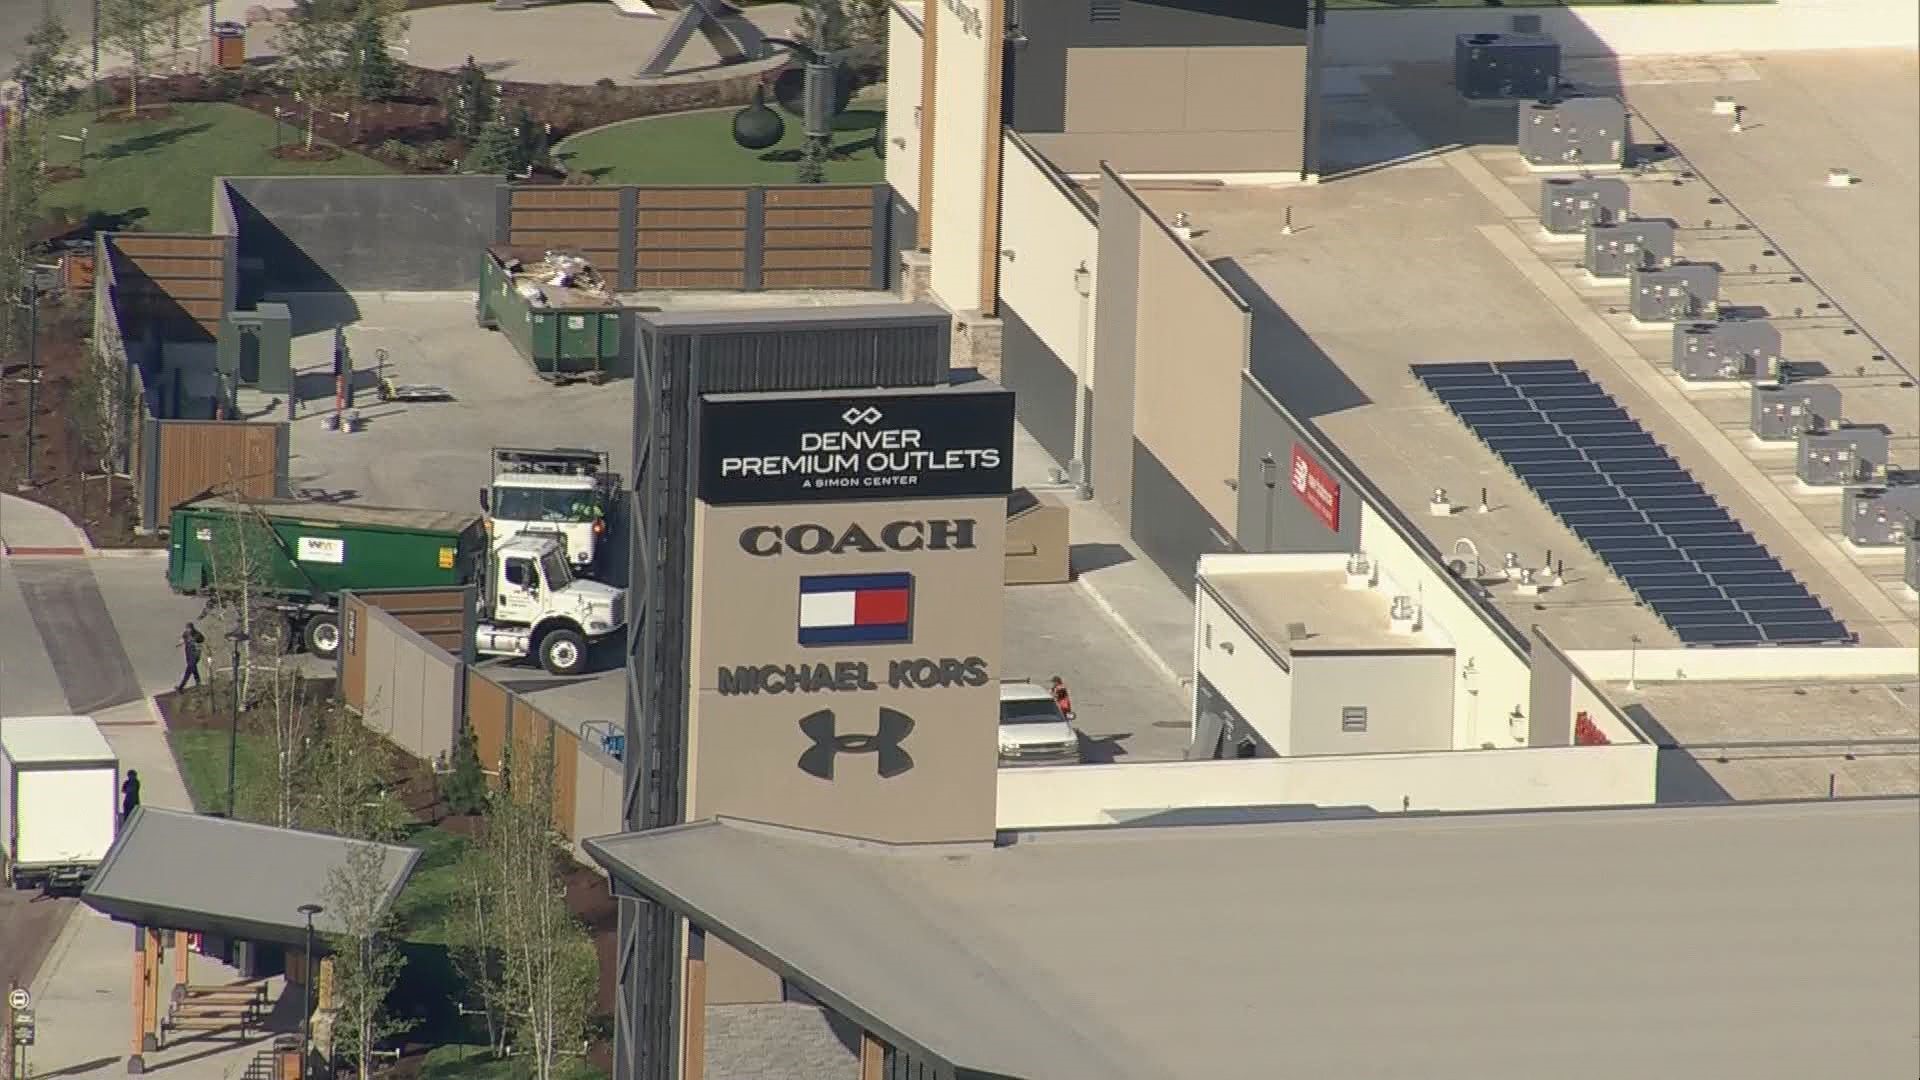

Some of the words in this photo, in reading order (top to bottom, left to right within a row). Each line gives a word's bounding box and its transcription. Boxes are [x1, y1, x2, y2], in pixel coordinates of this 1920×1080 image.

[801, 429, 921, 452] DENVER
[721, 453, 860, 477] PREMIUM
[866, 449, 1001, 472] OUTLETS
[802, 478, 812, 488] A
[815, 478, 860, 488] SIMON
[863, 475, 918, 487] CENTER
[738, 518, 978, 557] COACH
[717, 661, 878, 697] MICHAEL
[888, 656, 990, 690] KORS
